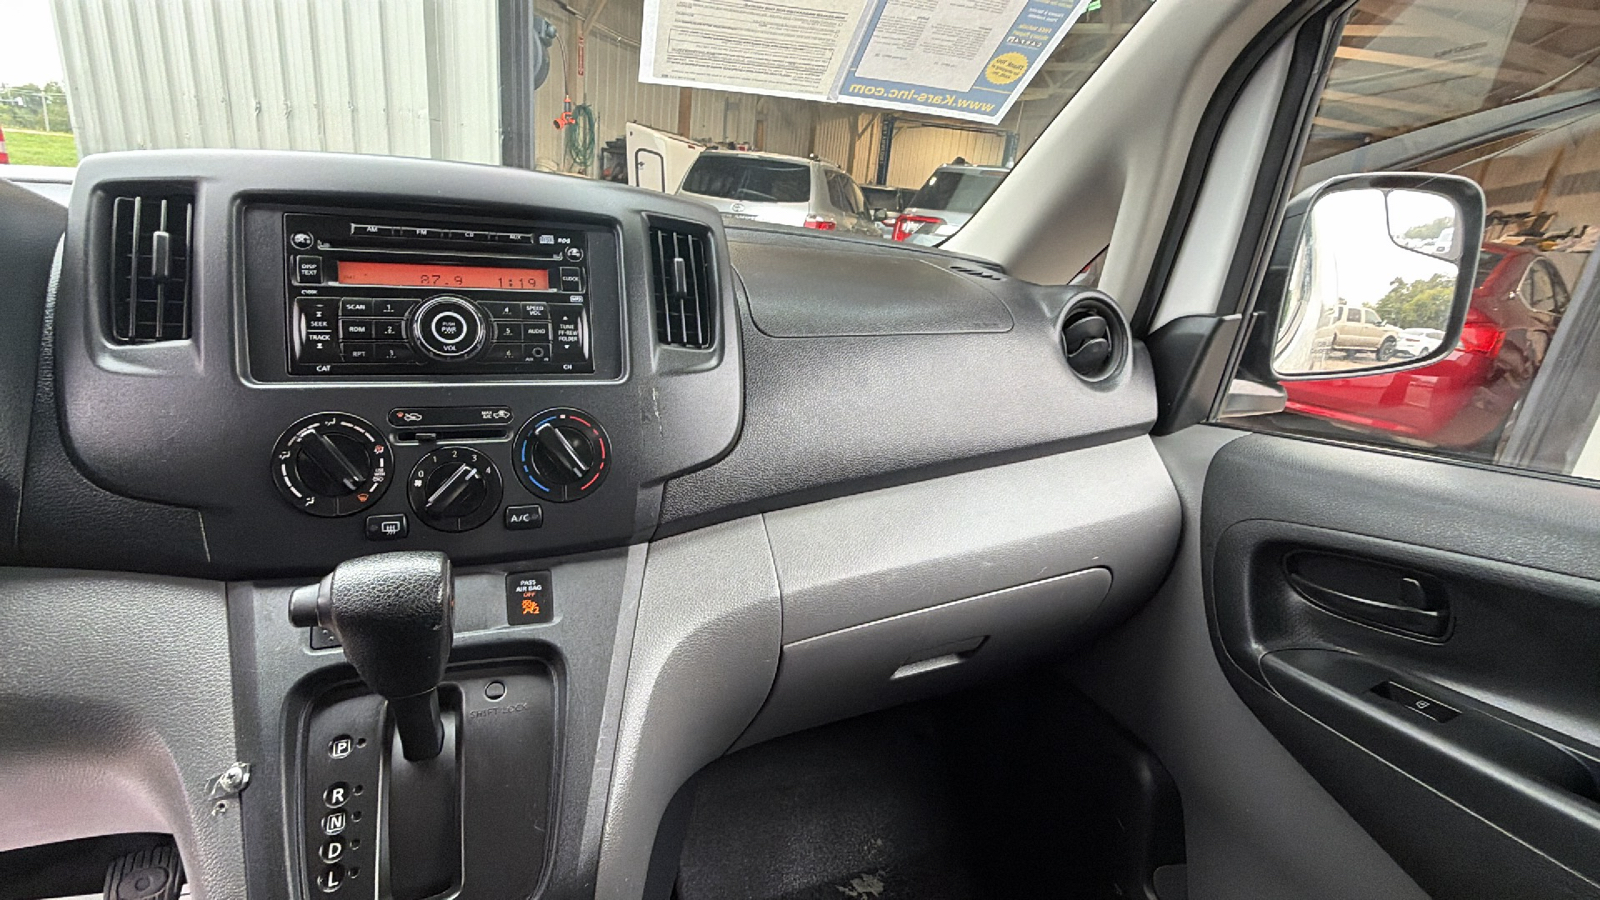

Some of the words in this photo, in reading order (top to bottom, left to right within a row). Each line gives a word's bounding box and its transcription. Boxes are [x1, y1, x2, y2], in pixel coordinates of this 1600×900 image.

[498, 277, 536, 288] 1:19
[452, 450, 458, 458] 2
[471, 454, 478, 462] 3
[485, 466, 491, 474] 4
[510, 513, 530, 523] A/C
[470, 707, 498, 719] SHIFT
[502, 702, 529, 714] LOCK
[337, 742, 347, 754] P
[332, 788, 344, 803] R
[330, 815, 342, 829] N
[328, 842, 342, 858] D
[328, 871, 339, 887] L
